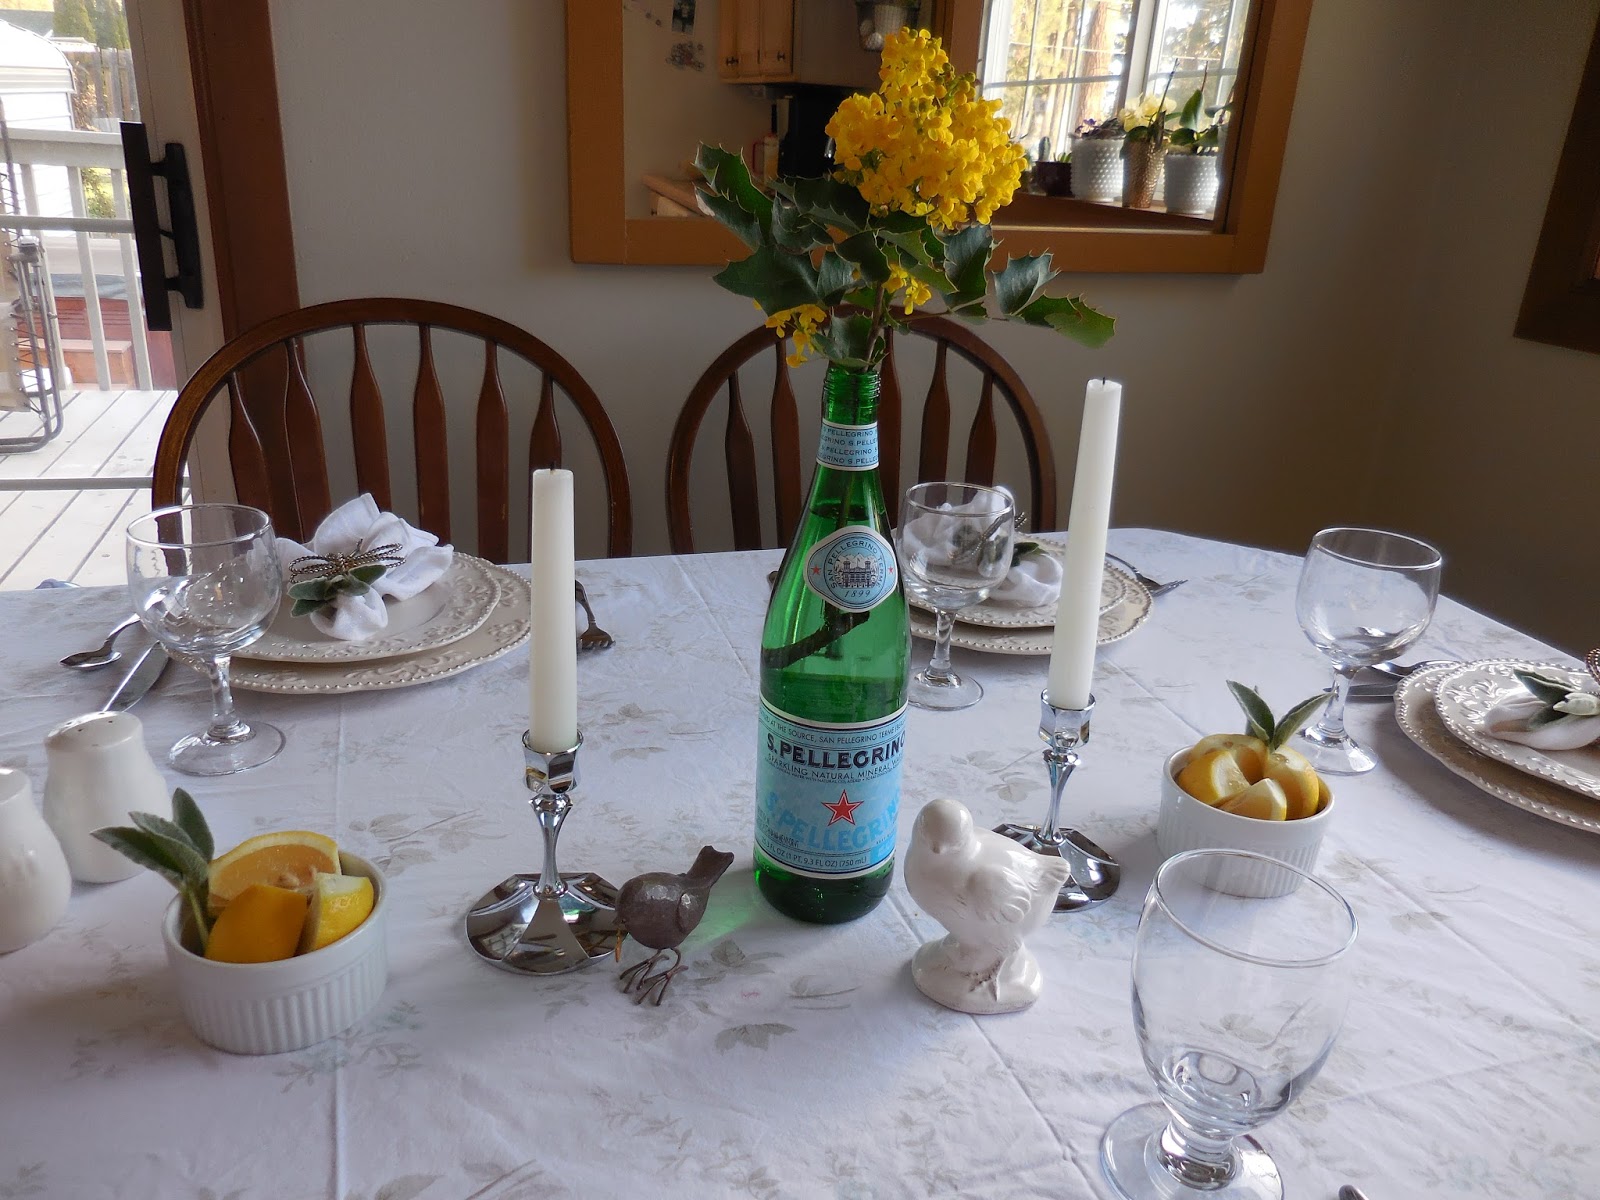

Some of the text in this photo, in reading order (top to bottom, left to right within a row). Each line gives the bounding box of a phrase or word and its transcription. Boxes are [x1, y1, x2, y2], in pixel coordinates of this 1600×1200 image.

[827, 540, 878, 566] PELLEGRINO
[827, 569, 838, 589] SAN
[844, 589, 871, 598] 1899
[819, 735, 835, 744] SAN
[837, 733, 877, 744] PELLEGRINO
[768, 753, 809, 776] SPARKLING
[811, 770, 855, 780] NATURAL
[857, 763, 890, 777] MINERAL
[803, 857, 814, 866] 9.3
[815, 859, 824, 867] FL
[825, 860, 839, 868] OZ)
[839, 859, 854, 868] (750
